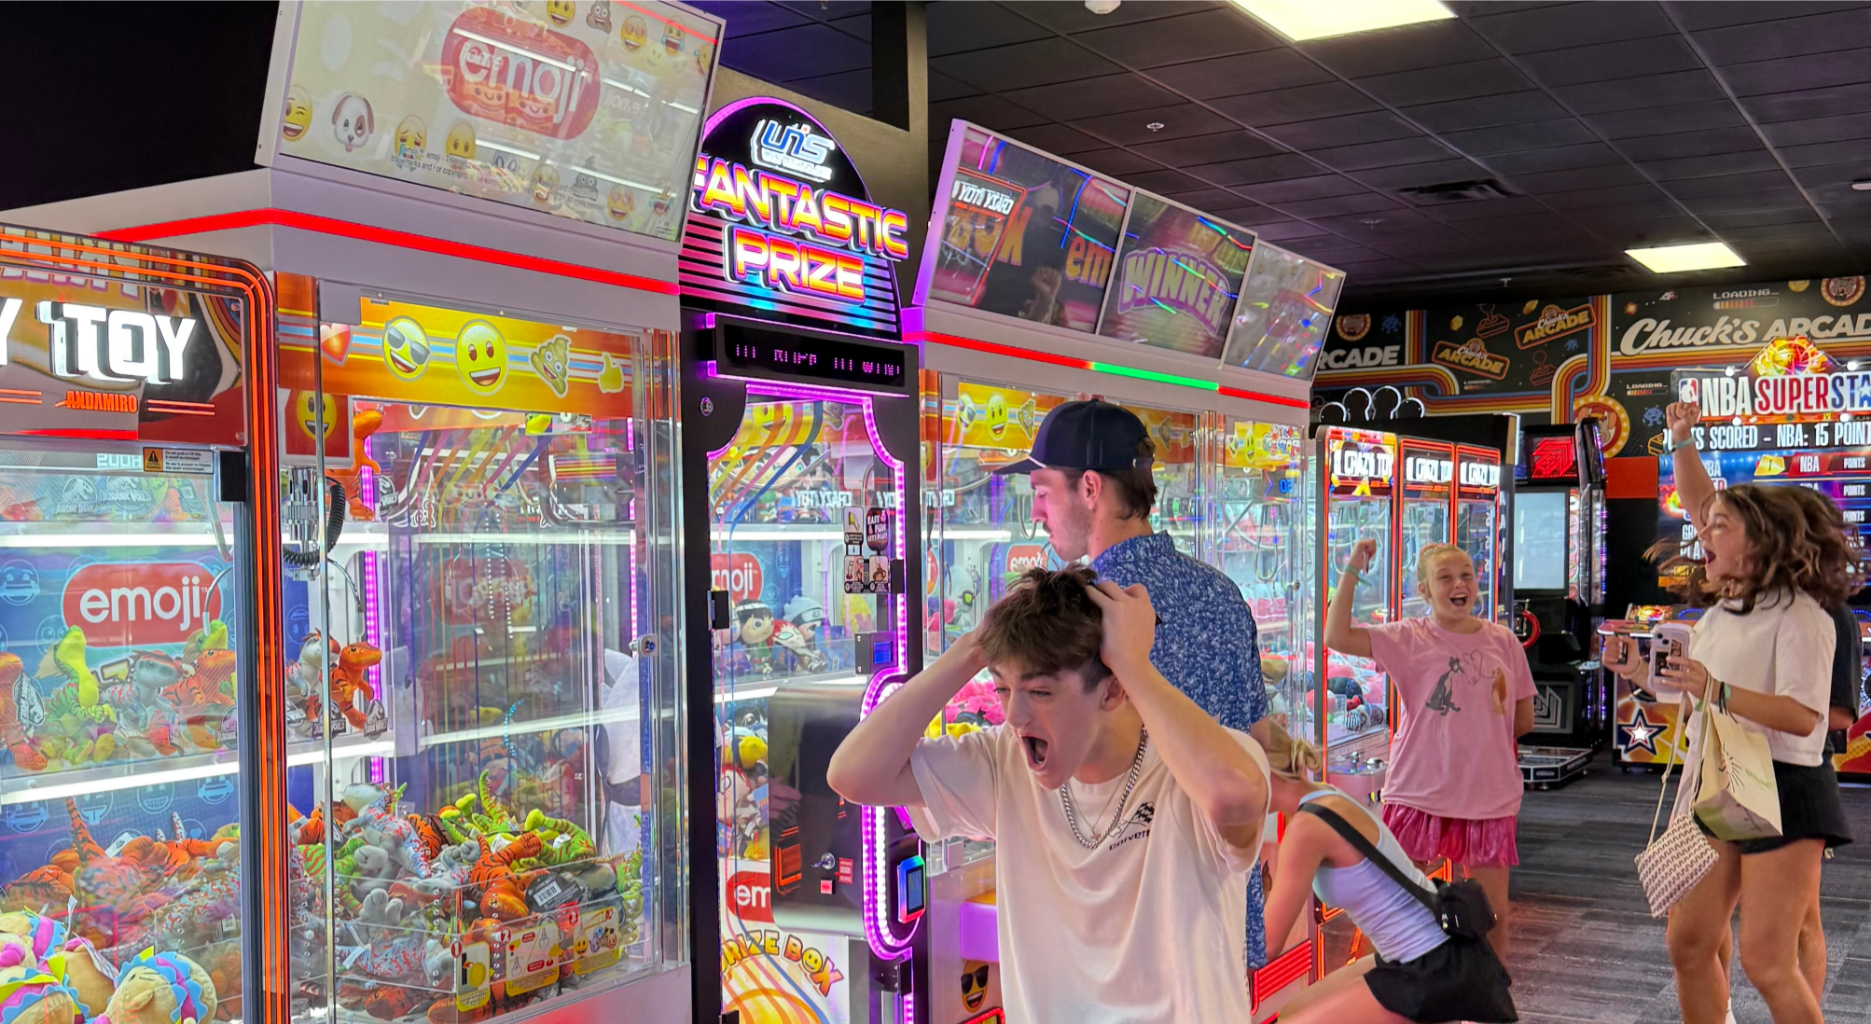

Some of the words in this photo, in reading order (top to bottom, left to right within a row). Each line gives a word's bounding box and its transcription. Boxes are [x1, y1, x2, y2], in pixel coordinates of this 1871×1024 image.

[459, 39, 587, 124] emoji
[734, 228, 866, 303] PRIZE
[1119, 248, 1229, 336] WINNER
[62, 303, 197, 382] TOY
[1522, 310, 1589, 344] ARCADE
[1620, 316, 1760, 357] Chuck's
[1437, 348, 1504, 374] ARCADE
[60, 390, 138, 414] ANDAMIRO
[1702, 377, 1752, 417] NBA
[1709, 425, 1758, 450] SCORED
[1776, 423, 1809, 448] NBA:
[1814, 423, 1829, 447] 15
[1799, 455, 1820, 474] NBA
[1843, 457, 1866, 470] POINTS
[1843, 484, 1866, 497] POINTS
[79, 576, 200, 632] emoji
